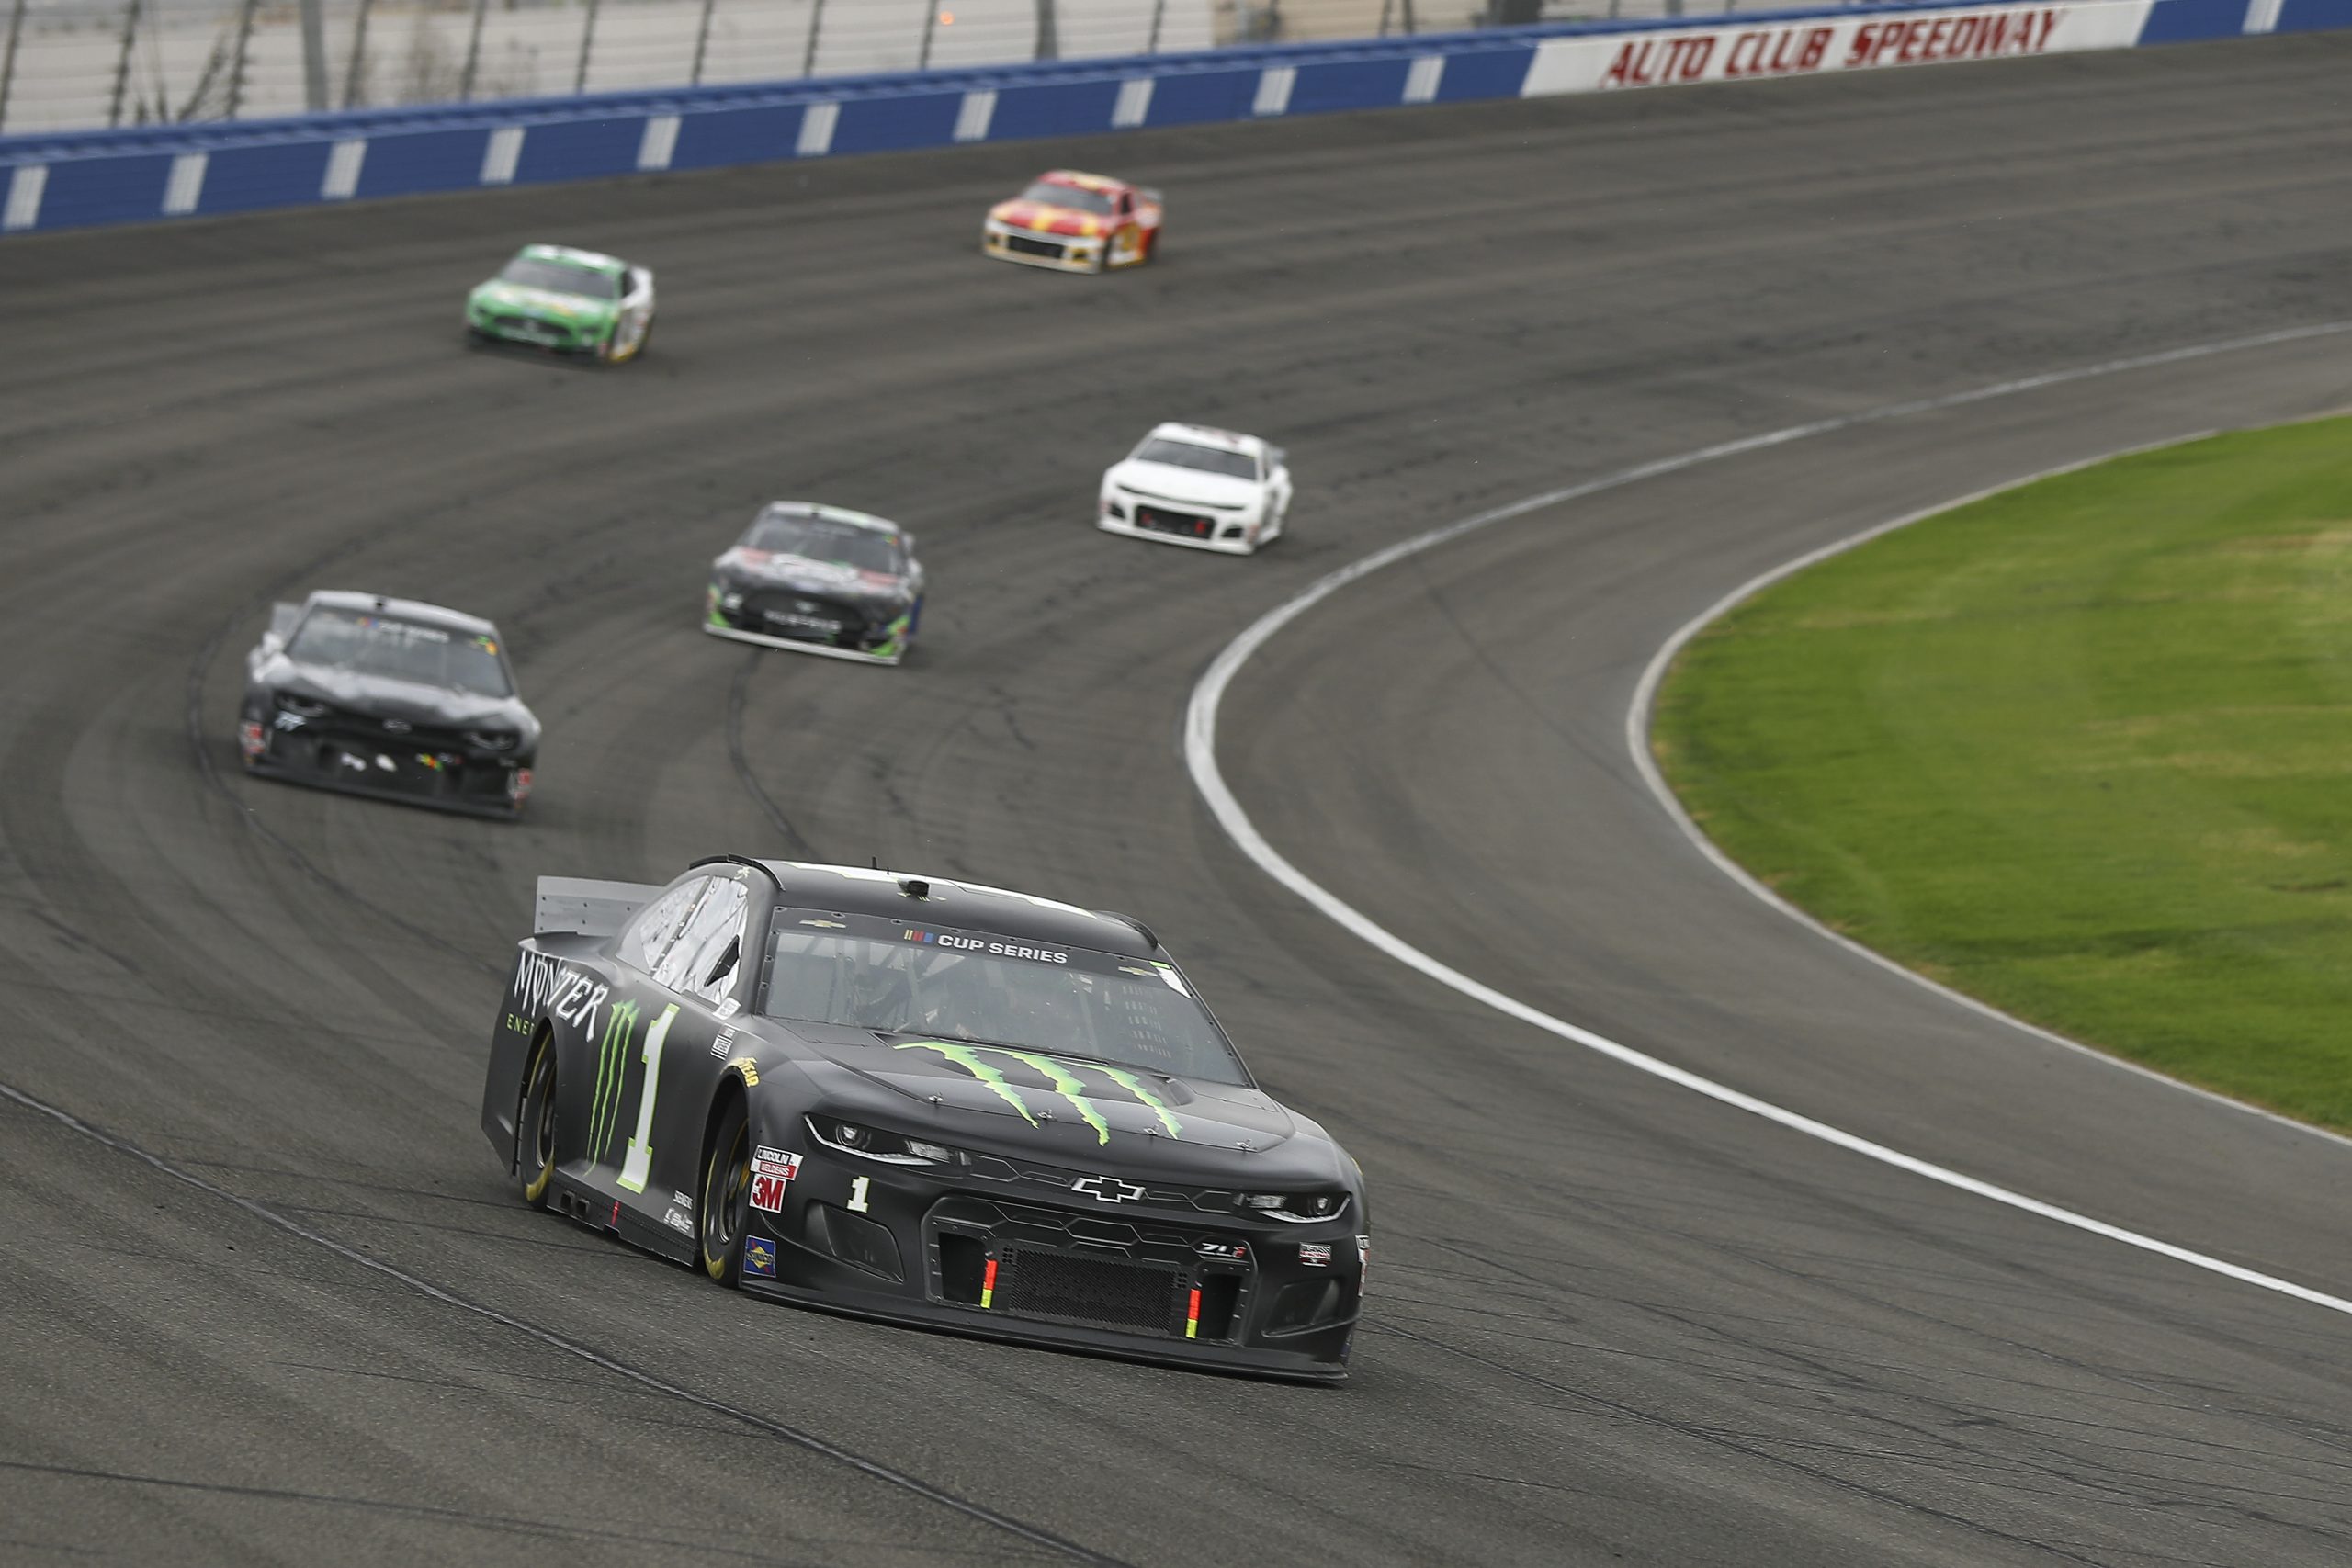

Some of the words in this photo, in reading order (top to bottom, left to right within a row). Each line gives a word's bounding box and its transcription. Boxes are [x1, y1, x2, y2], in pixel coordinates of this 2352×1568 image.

[1600, 36, 1716, 87] AUTO
[1724, 26, 1835, 78] CLUB
[1844, 8, 2066, 67] SPEEDWAY
[937, 934, 985, 951] CUP
[988, 942, 1069, 964] SERIES
[616, 1003, 680, 1194] 1
[757, 1148, 790, 1165] LINCOLN
[752, 1176, 785, 1212] 3M
[847, 1176, 871, 1213] 1
